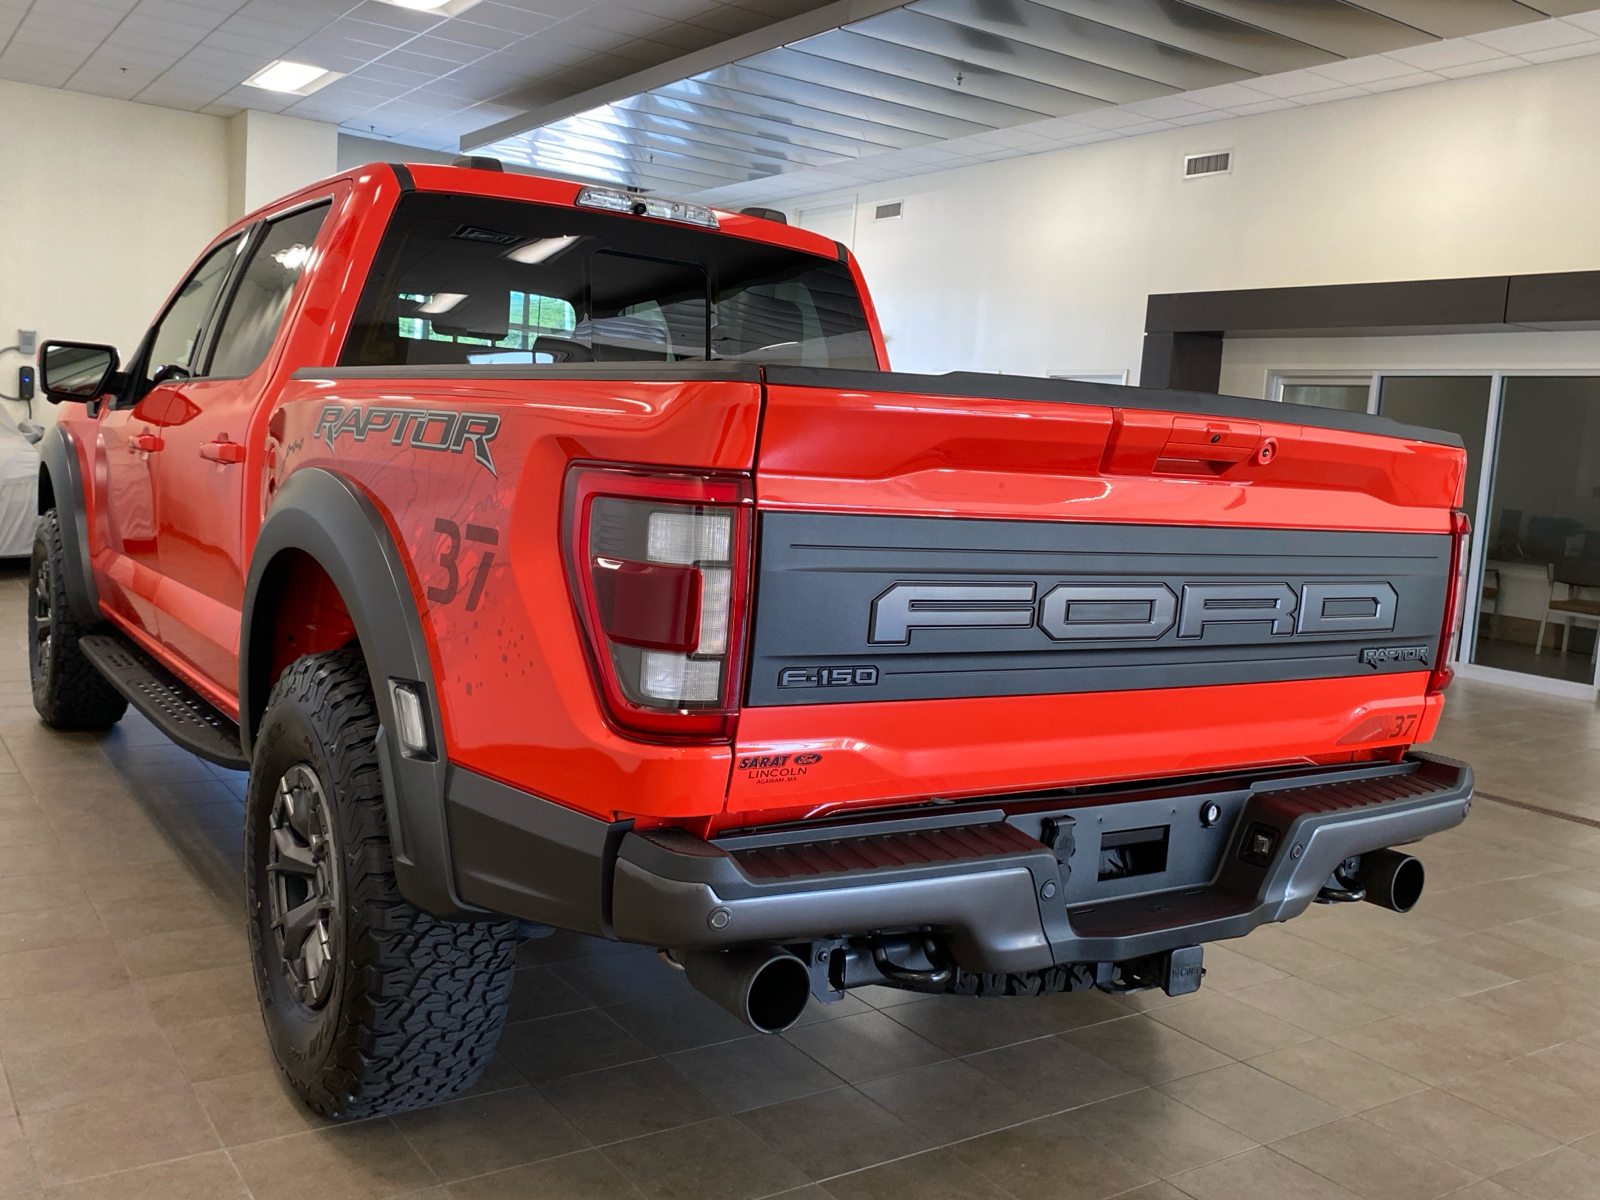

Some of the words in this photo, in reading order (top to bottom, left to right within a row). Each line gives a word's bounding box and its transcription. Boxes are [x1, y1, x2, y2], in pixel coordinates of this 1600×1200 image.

[314, 405, 501, 481] RAPTOR
[427, 518, 499, 612] 37
[868, 581, 1398, 646] FORD
[1359, 645, 1430, 669] RAPTOR
[778, 665, 879, 688] F-150
[1389, 714, 1417, 738] 37
[739, 754, 790, 769] SARAT
[748, 767, 807, 779] LINCOLN
